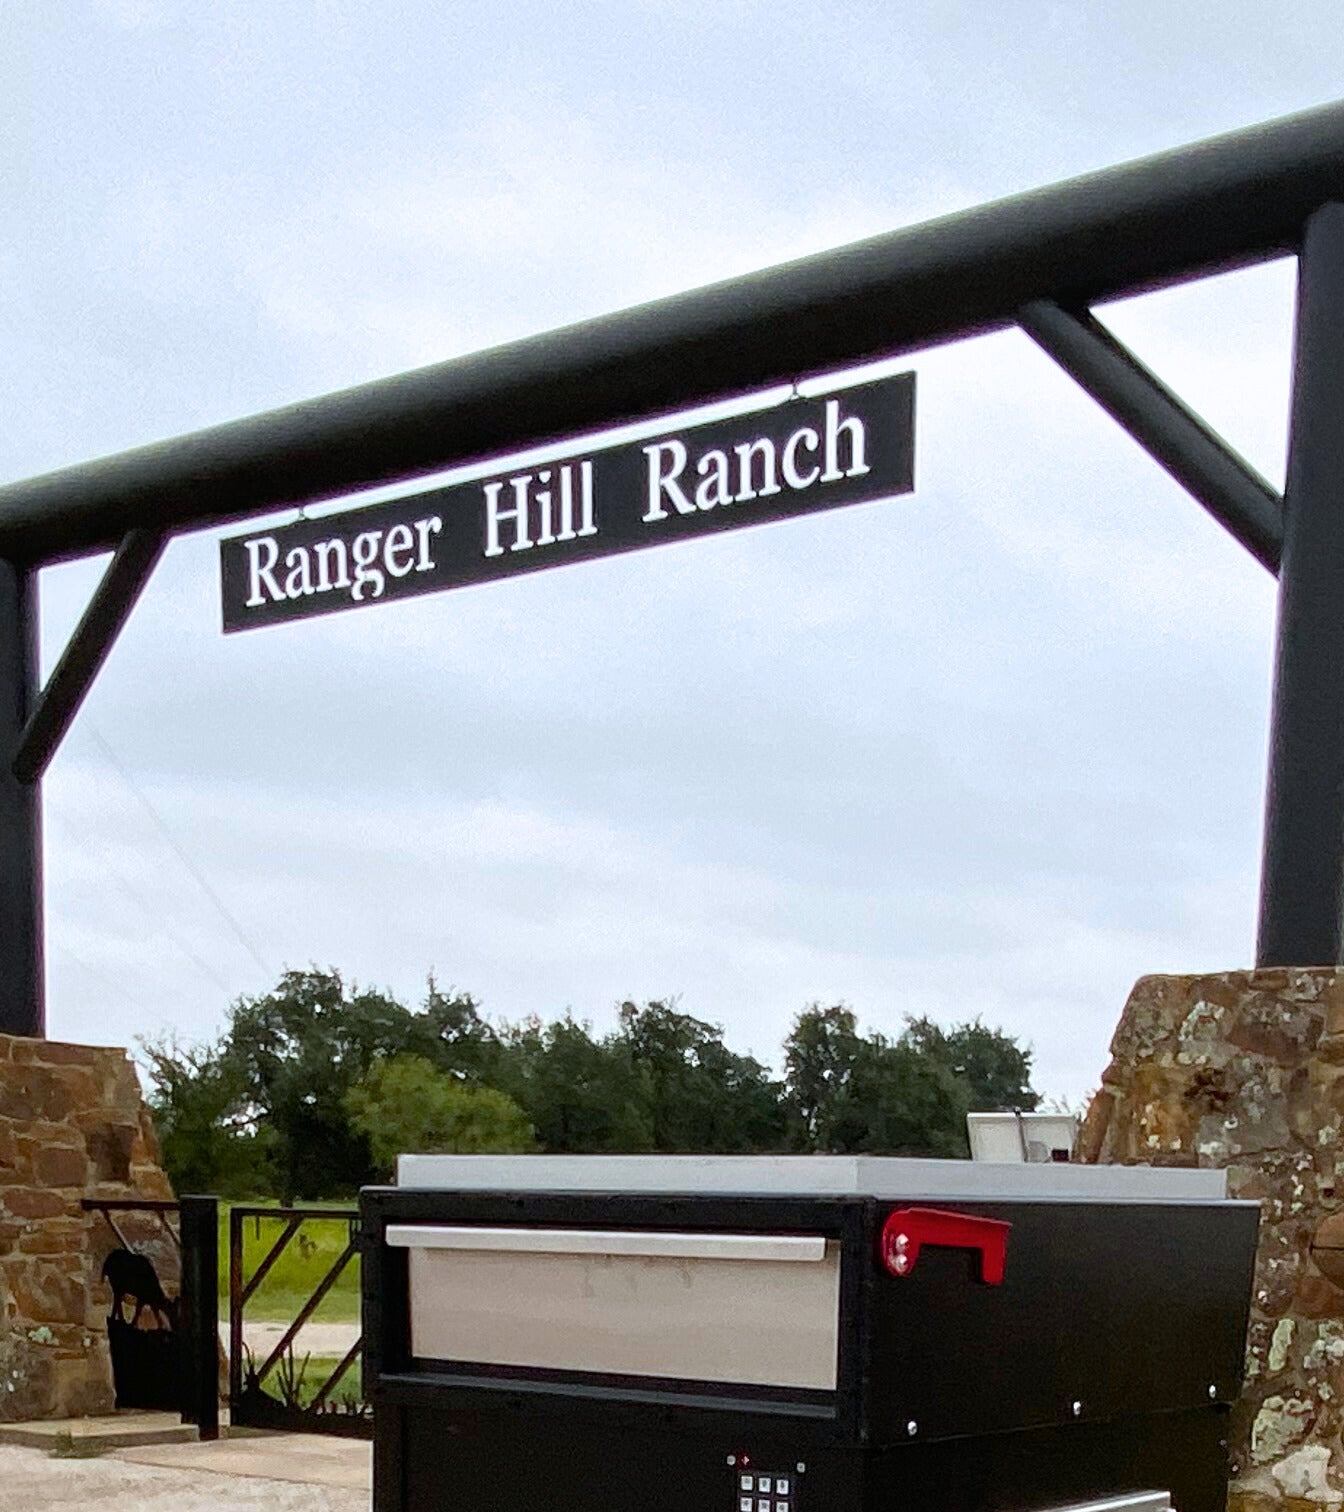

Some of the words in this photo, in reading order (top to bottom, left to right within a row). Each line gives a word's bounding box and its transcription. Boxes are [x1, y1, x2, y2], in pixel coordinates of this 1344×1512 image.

[243, 511, 442, 607] Ranger
[482, 460, 597, 557] Hill
[642, 400, 870, 524] Ranch
